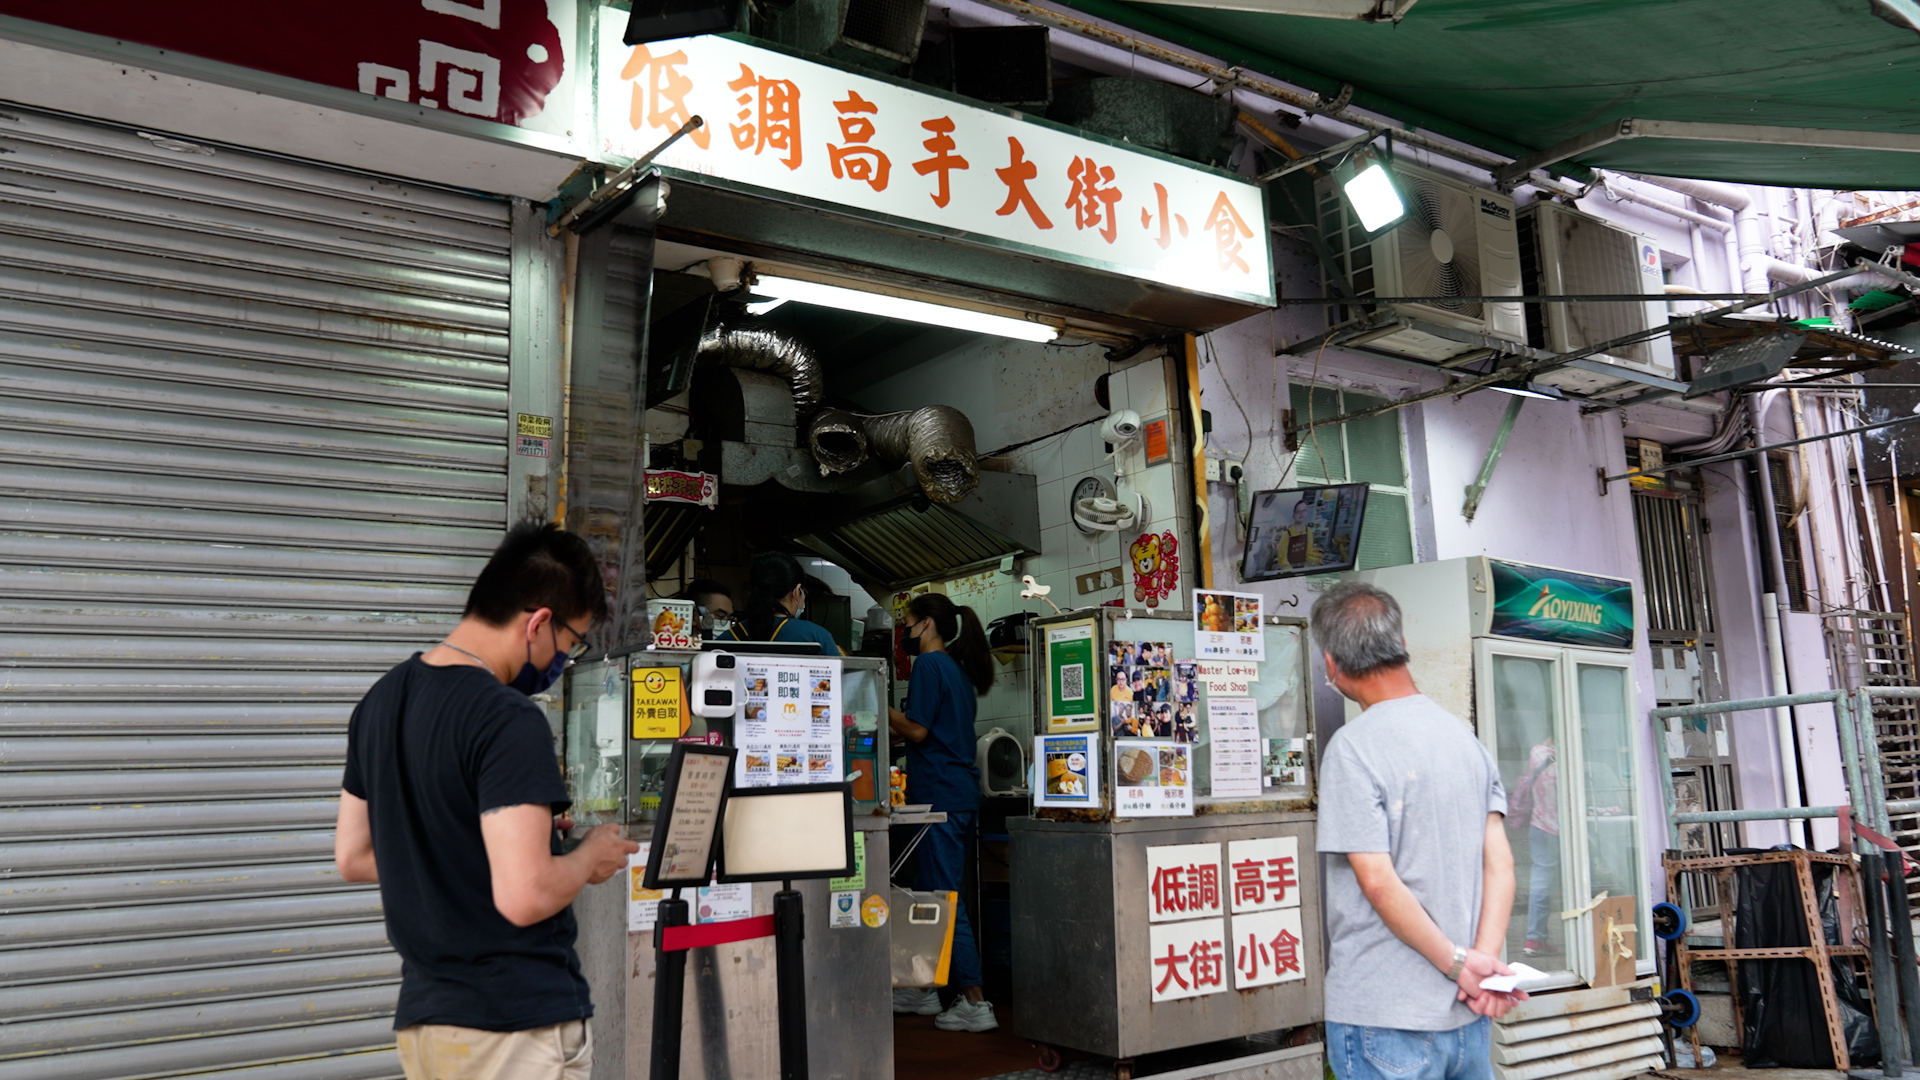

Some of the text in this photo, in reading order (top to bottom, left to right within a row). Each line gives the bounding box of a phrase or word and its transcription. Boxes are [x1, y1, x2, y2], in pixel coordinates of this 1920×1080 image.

[620, 43, 1254, 275] 低調高手大街小食
[1481, 198, 1510, 215] McQuay
[1641, 264, 1661, 278] GREE
[518, 446, 547, 456] 69111711
[778, 671, 800, 683] 即叫
[1198, 665, 1256, 677] Master Low-key
[778, 686, 800, 699] 即製
[1209, 681, 1247, 692] Food Shop
[636, 698, 678, 706] TAKEAWAY
[636, 708, 678, 719] 外賣自取
[675, 806, 692, 815] Monday
[697, 808, 712, 816] Sunday
[1151, 856, 1298, 915] 低調 高手
[1153, 928, 1301, 994] 大街 小食
